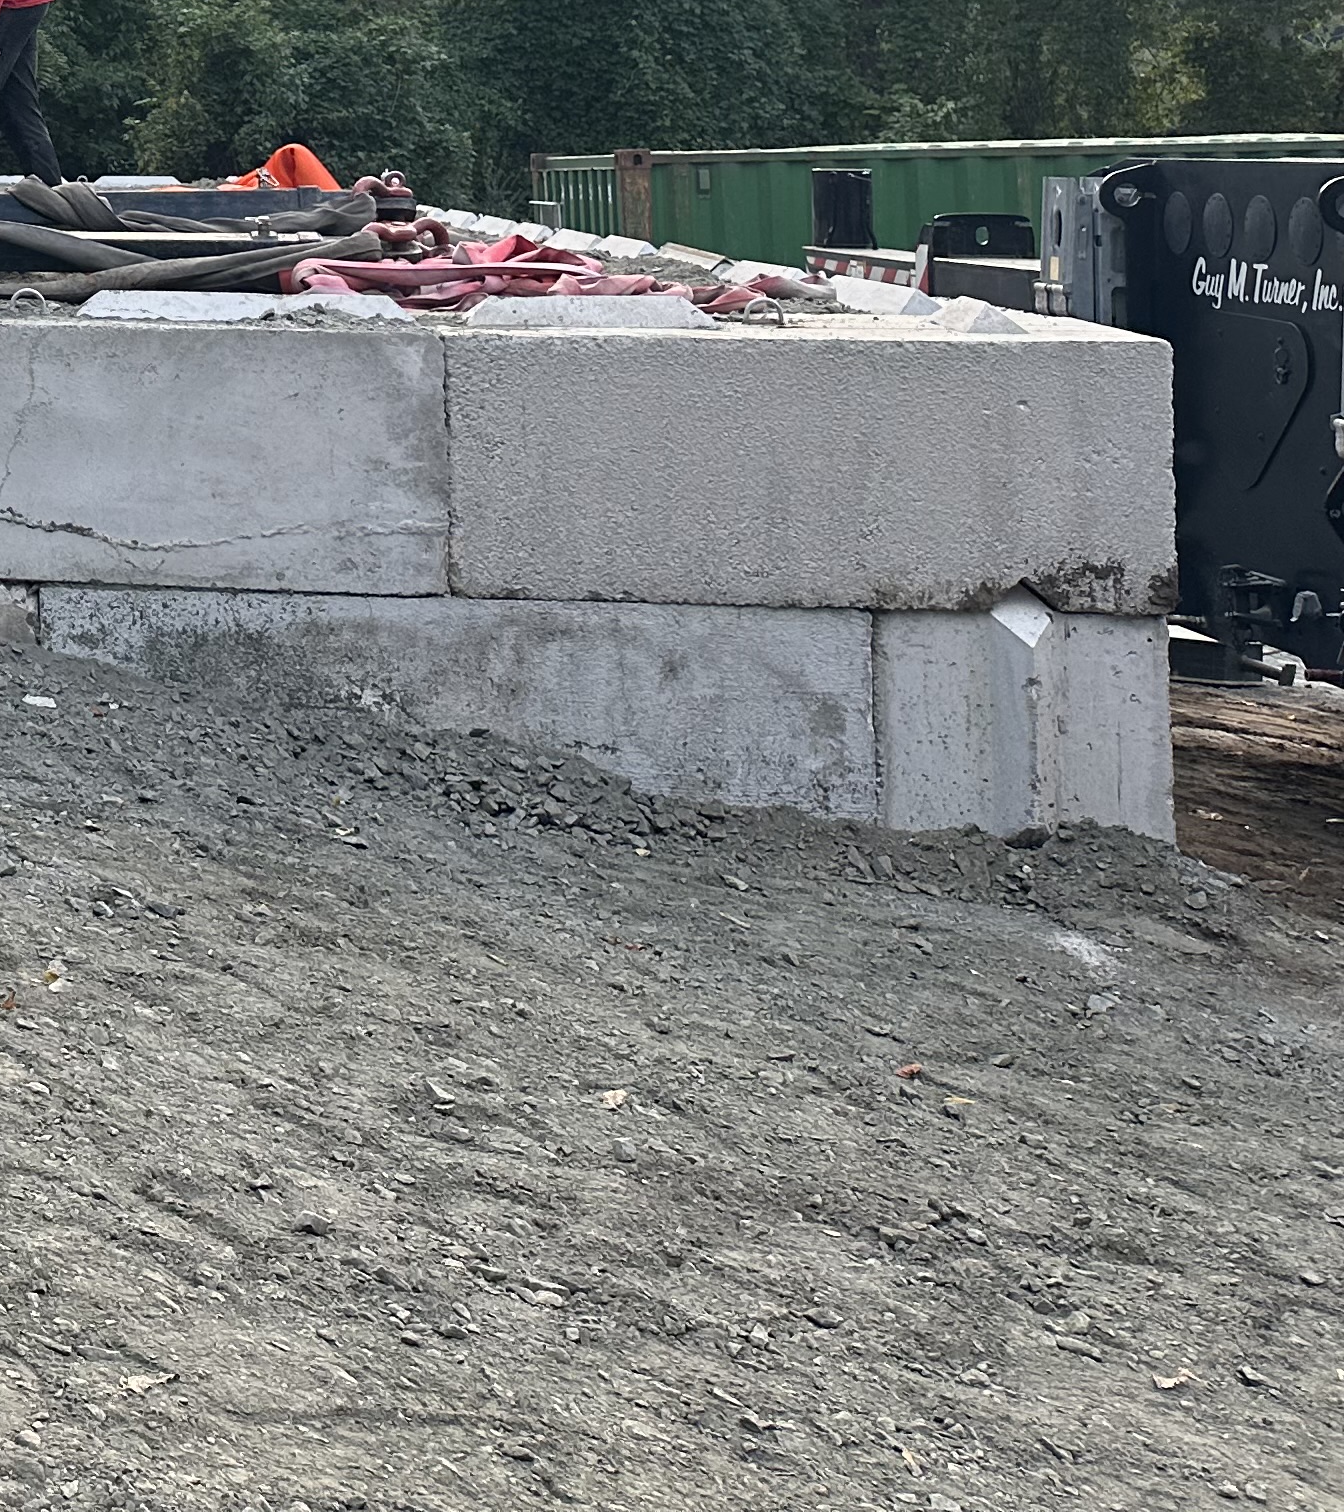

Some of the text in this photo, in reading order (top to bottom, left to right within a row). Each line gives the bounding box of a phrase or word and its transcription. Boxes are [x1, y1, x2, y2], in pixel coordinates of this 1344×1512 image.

[1192, 256, 1343, 313] Guy M. Turner, Inc.
